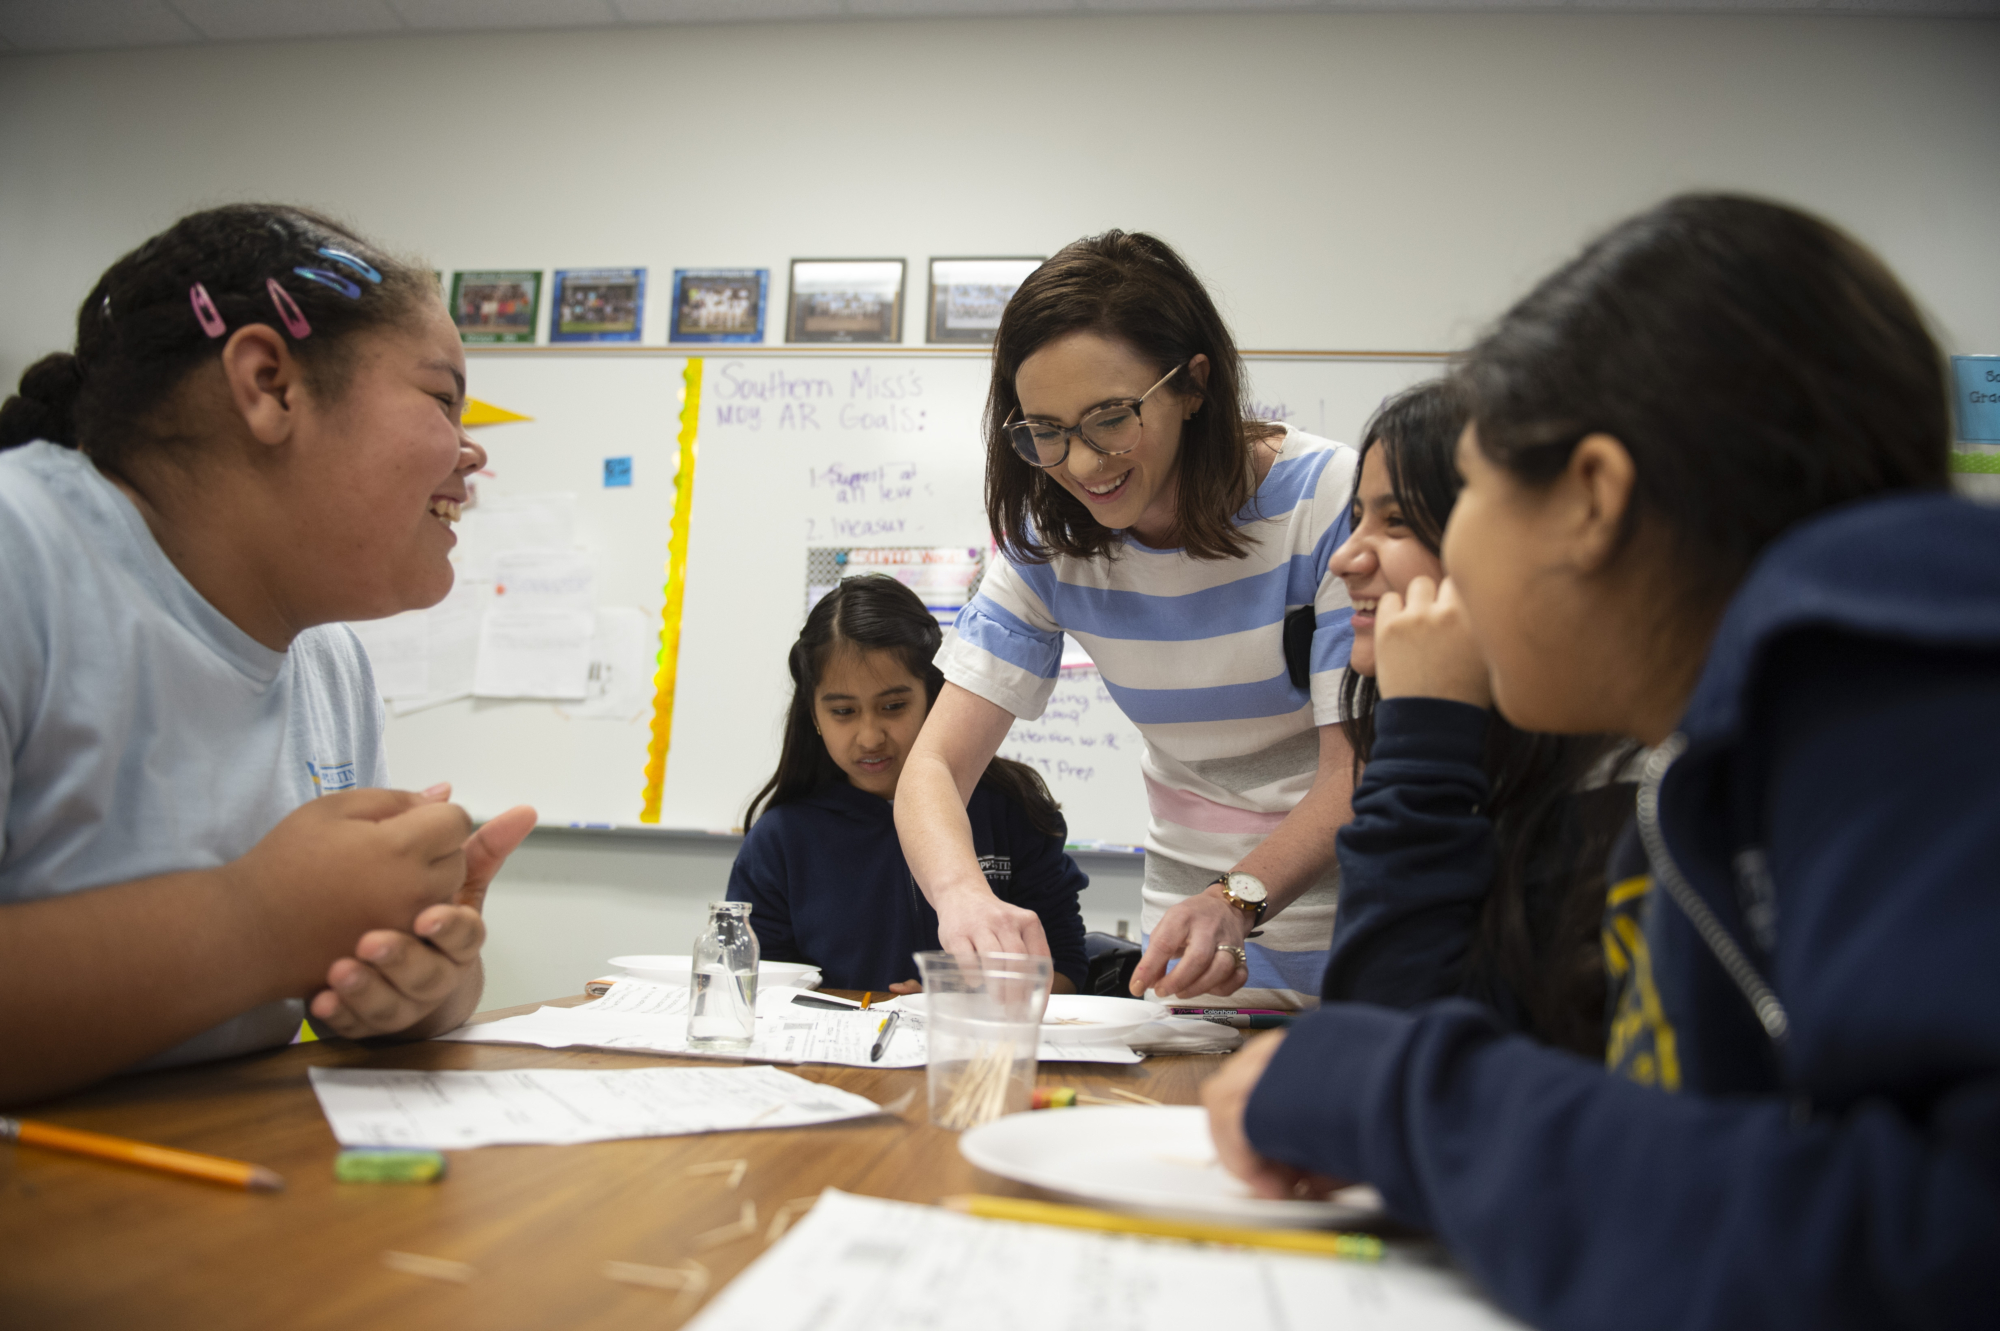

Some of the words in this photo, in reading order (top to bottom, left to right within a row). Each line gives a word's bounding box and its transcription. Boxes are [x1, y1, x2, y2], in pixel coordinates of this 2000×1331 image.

[713, 360, 834, 402] Southern
[850, 365, 923, 401] Miss's
[1969, 390, 2000, 404] Gra
[779, 402, 822, 431] AR
